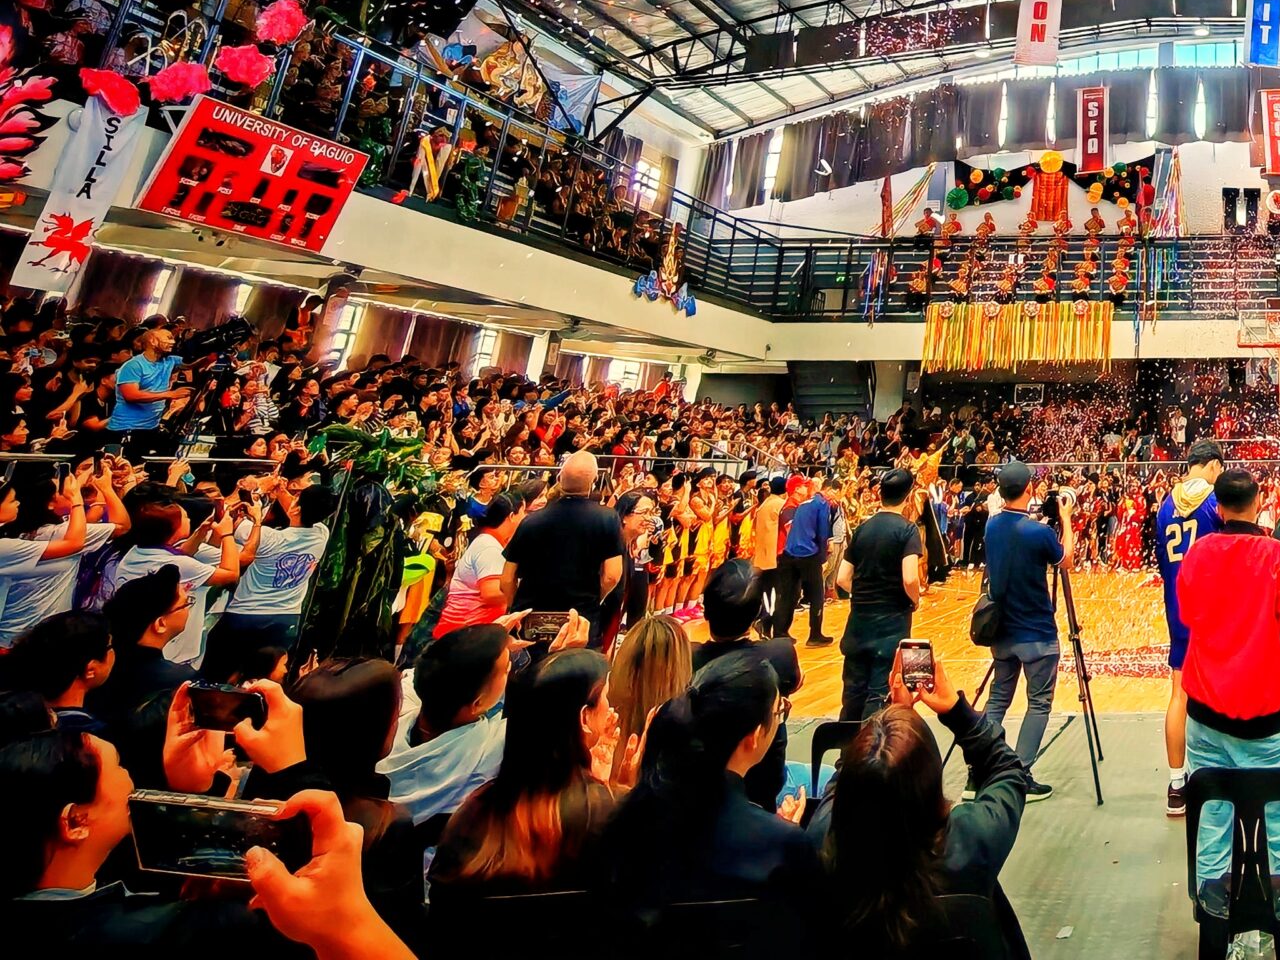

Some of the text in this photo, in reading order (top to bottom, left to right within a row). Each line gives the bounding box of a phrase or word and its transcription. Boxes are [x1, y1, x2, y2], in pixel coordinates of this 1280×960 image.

[76, 117, 121, 200] SILLA
[212, 106, 355, 165] UNIVERSITY OF BAGUIO
[1165, 519, 1198, 563] 27
